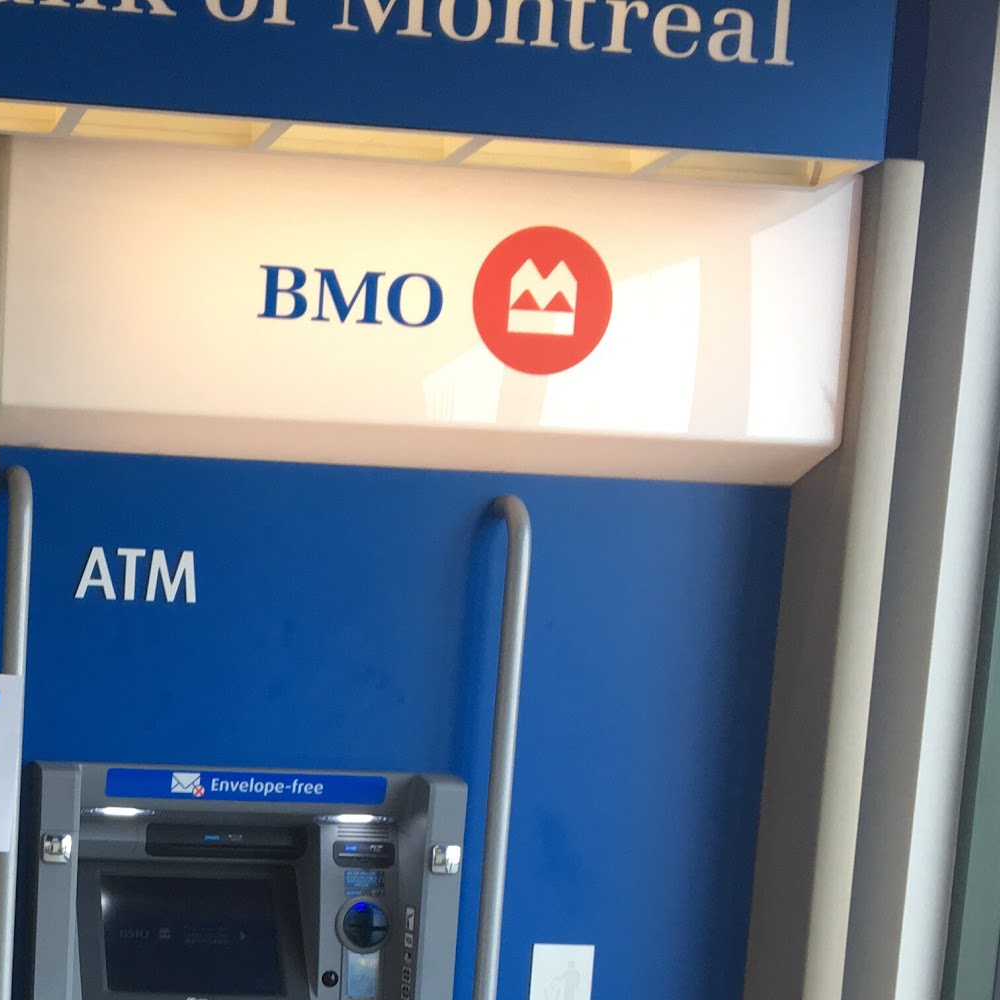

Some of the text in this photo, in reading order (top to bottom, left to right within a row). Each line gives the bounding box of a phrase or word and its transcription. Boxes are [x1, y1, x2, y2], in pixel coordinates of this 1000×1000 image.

[257, 264, 443, 327] BMO
[74, 546, 197, 603] ATM
[210, 777, 325, 796] Envelope-free
